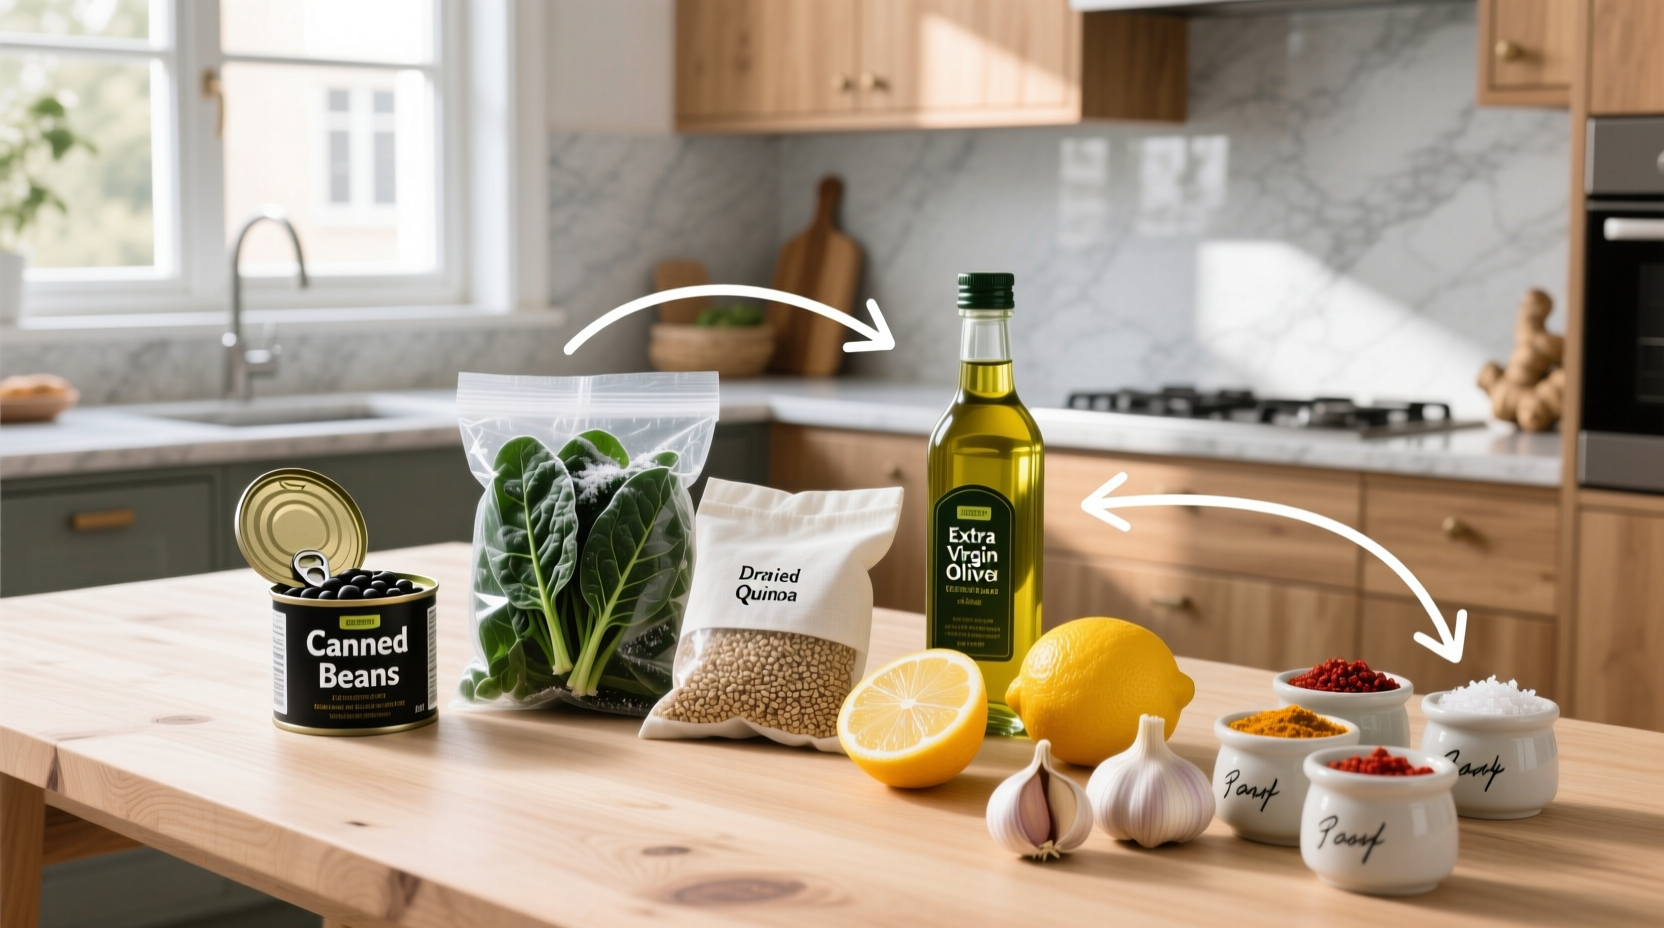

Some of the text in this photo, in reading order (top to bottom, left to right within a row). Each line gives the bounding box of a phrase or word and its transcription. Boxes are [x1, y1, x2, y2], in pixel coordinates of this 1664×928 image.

[949, 526, 996, 544] Extra
[735, 584, 797, 606] Quinoa
[306, 625, 409, 657] Canned
[319, 662, 400, 688] Beans
